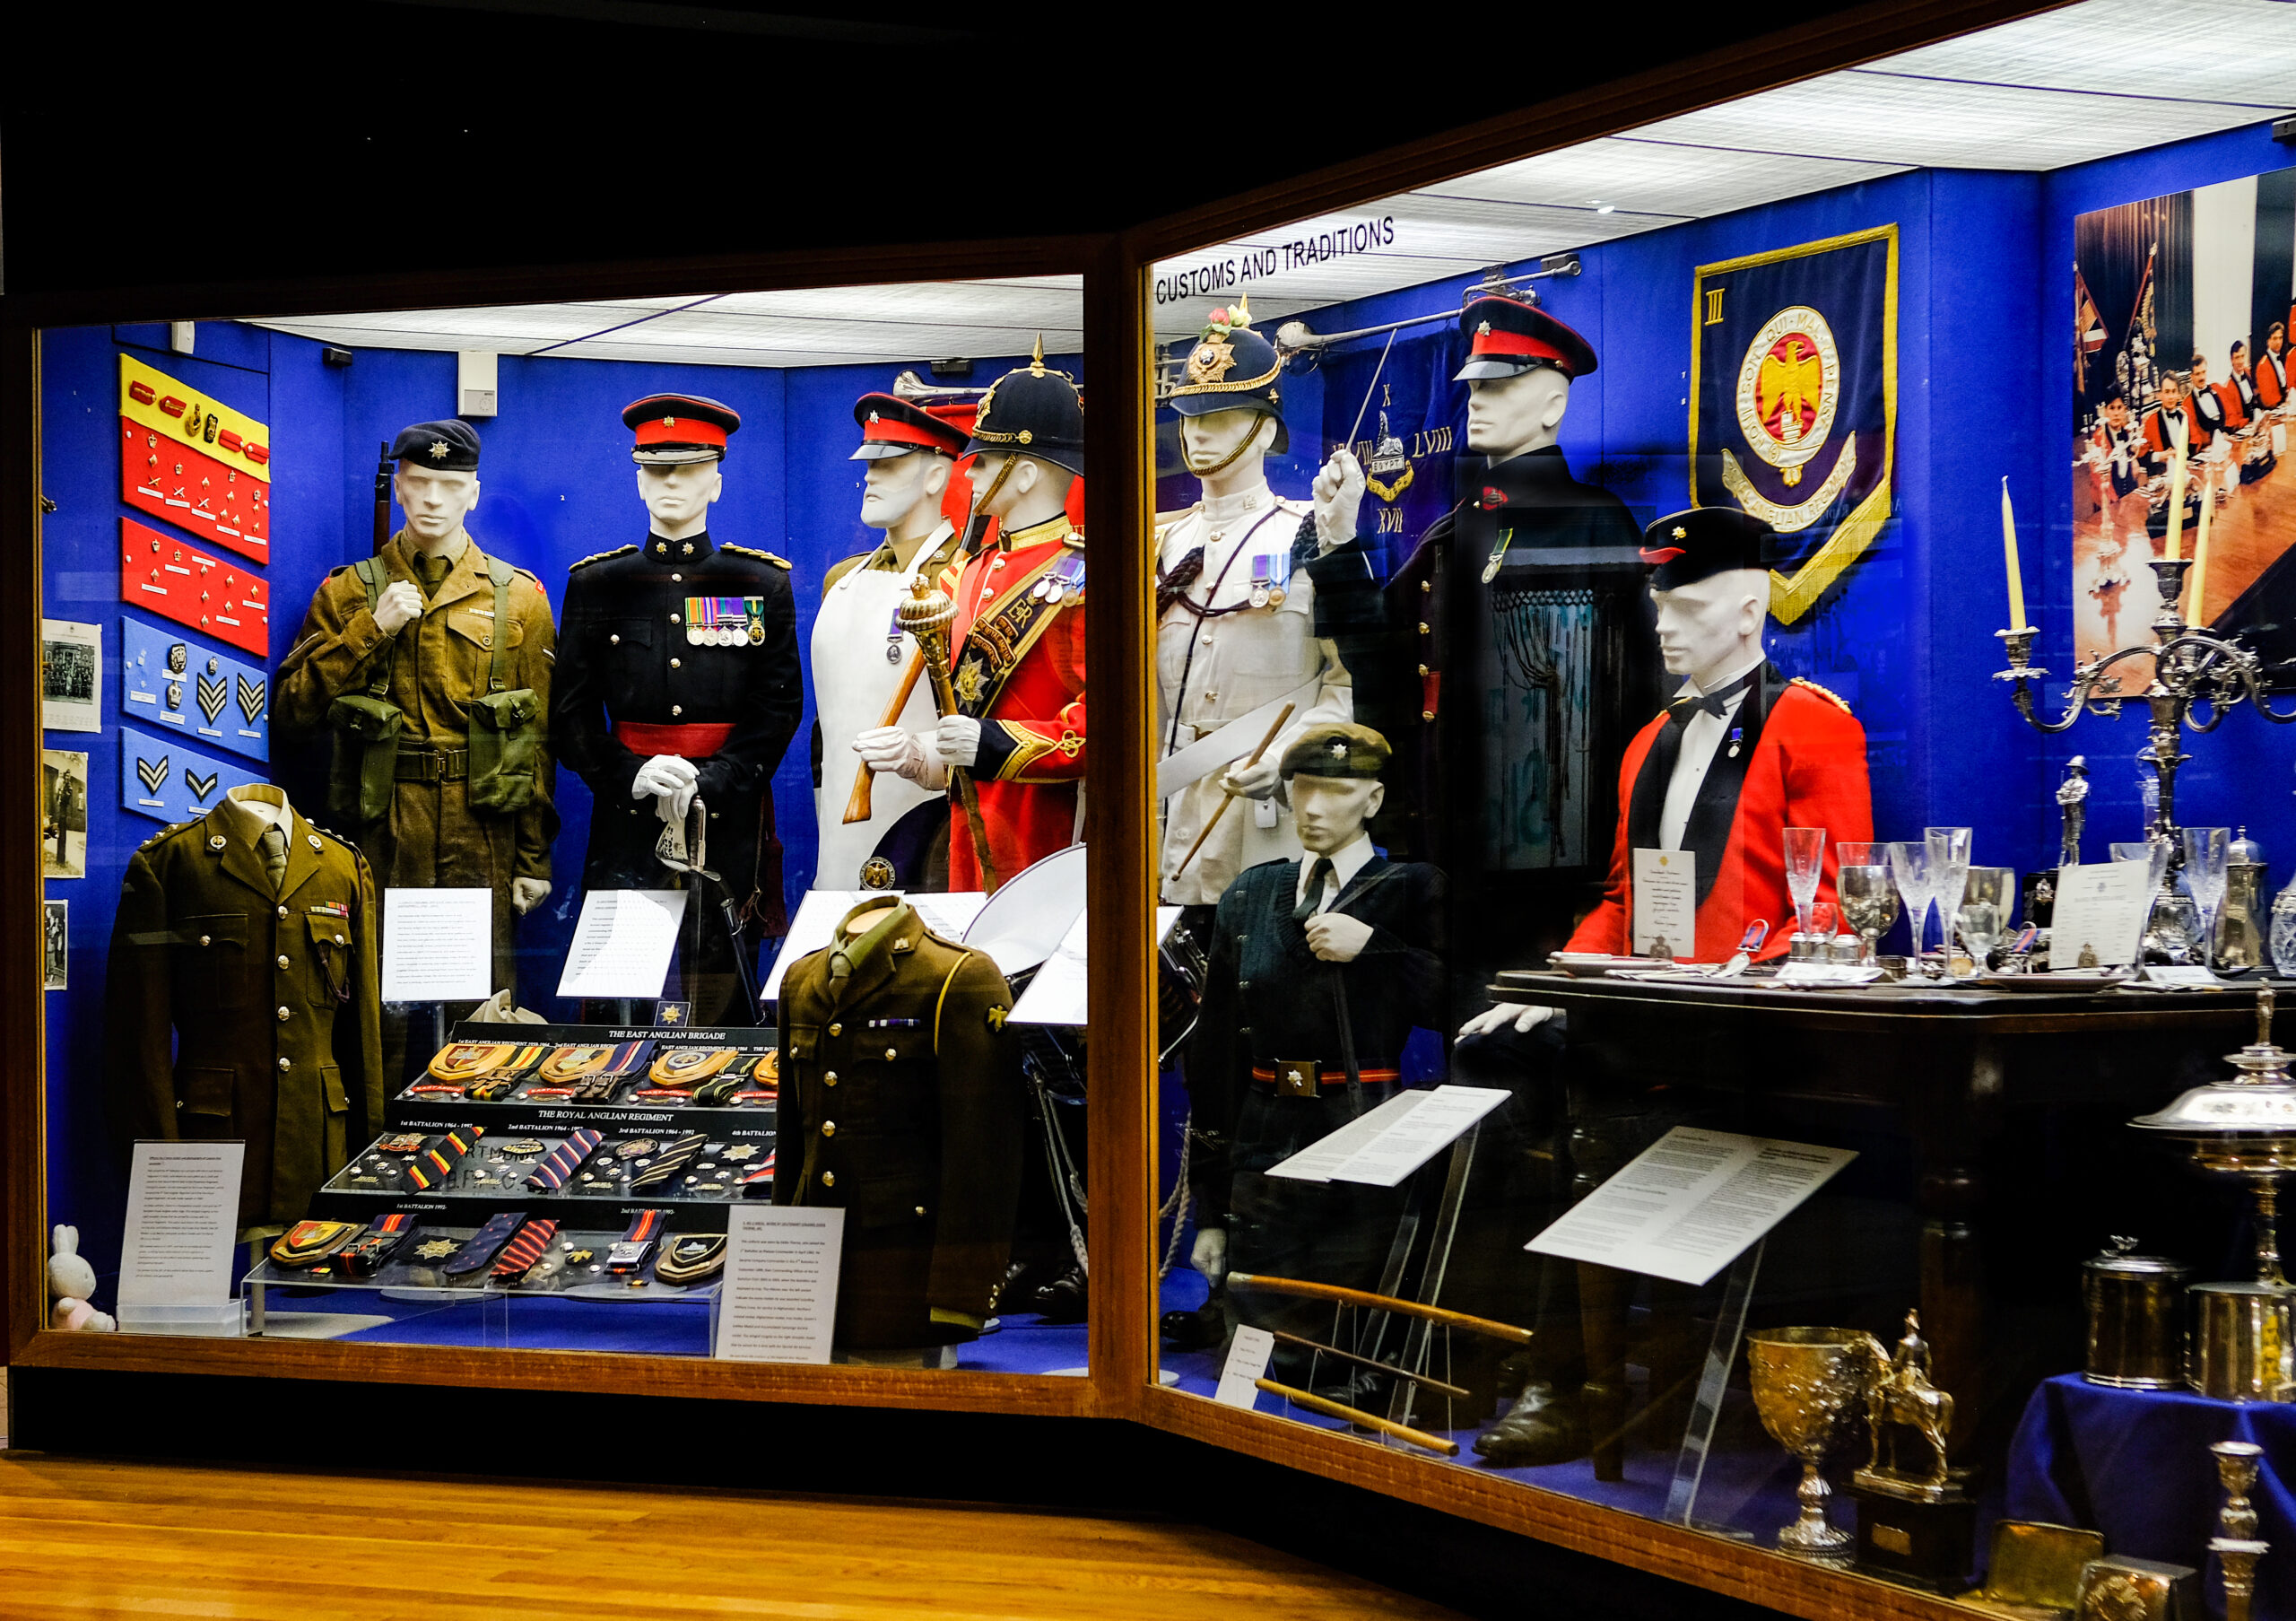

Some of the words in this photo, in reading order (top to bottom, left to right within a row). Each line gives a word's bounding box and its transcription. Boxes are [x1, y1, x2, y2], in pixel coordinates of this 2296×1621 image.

[1156, 259, 1236, 305] CUSTOMS
[1240, 248, 1277, 283] AND
[1282, 215, 1395, 271] TRADITIONS
[1705, 288, 1726, 326] III
[1766, 317, 1787, 342] QUI
[1796, 313, 1820, 339] MAL
[1382, 383, 1391, 407] X
[1412, 426, 1453, 458] LVIII
[1374, 459, 1399, 471] EGYPT
[1378, 507, 1403, 535] XVII
[1751, 501, 1805, 525] ANGLIAN
[609, 1030, 626, 1038] THE
[626, 1031, 648, 1039] EAST
[648, 1031, 687, 1040] ANGLIAN
[687, 1032, 726, 1041] BRIGADE
[538, 1110, 556, 1118] THE
[556, 1111, 586, 1120] ROYAL
[587, 1112, 627, 1120] ANGLIAN
[628, 1113, 674, 1121] REGIMENT
